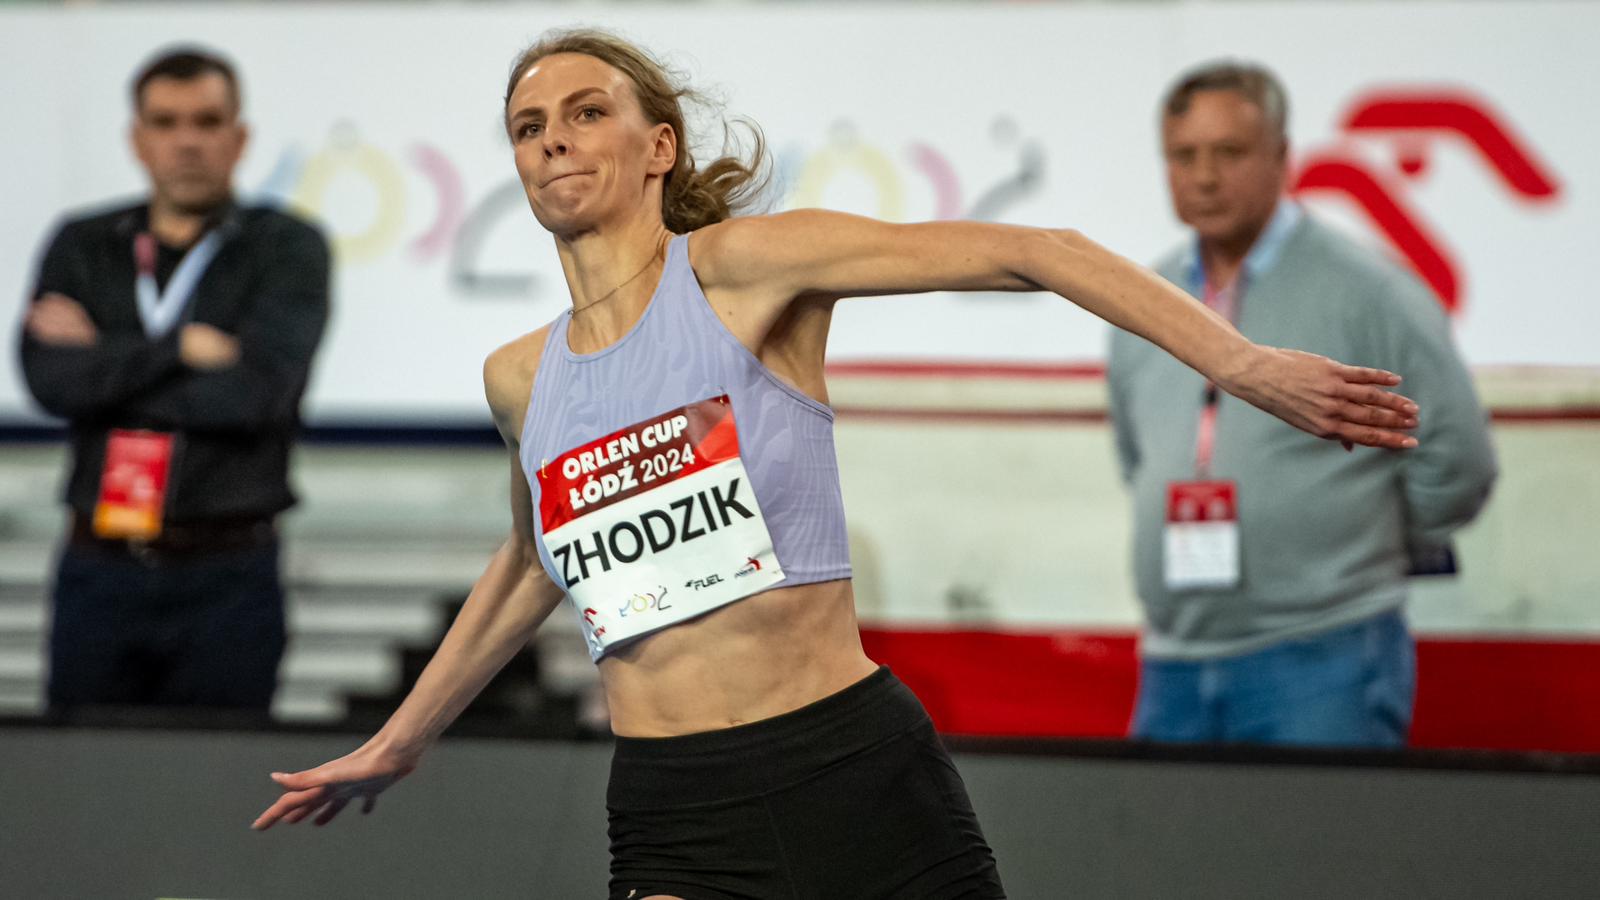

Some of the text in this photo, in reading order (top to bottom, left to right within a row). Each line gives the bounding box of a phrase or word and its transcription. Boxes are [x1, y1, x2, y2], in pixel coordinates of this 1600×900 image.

[562, 415, 688, 480] ORLEN CUP
[569, 443, 696, 511] ŁÓDŹ 2024
[553, 478, 755, 588] ZHODZIK
